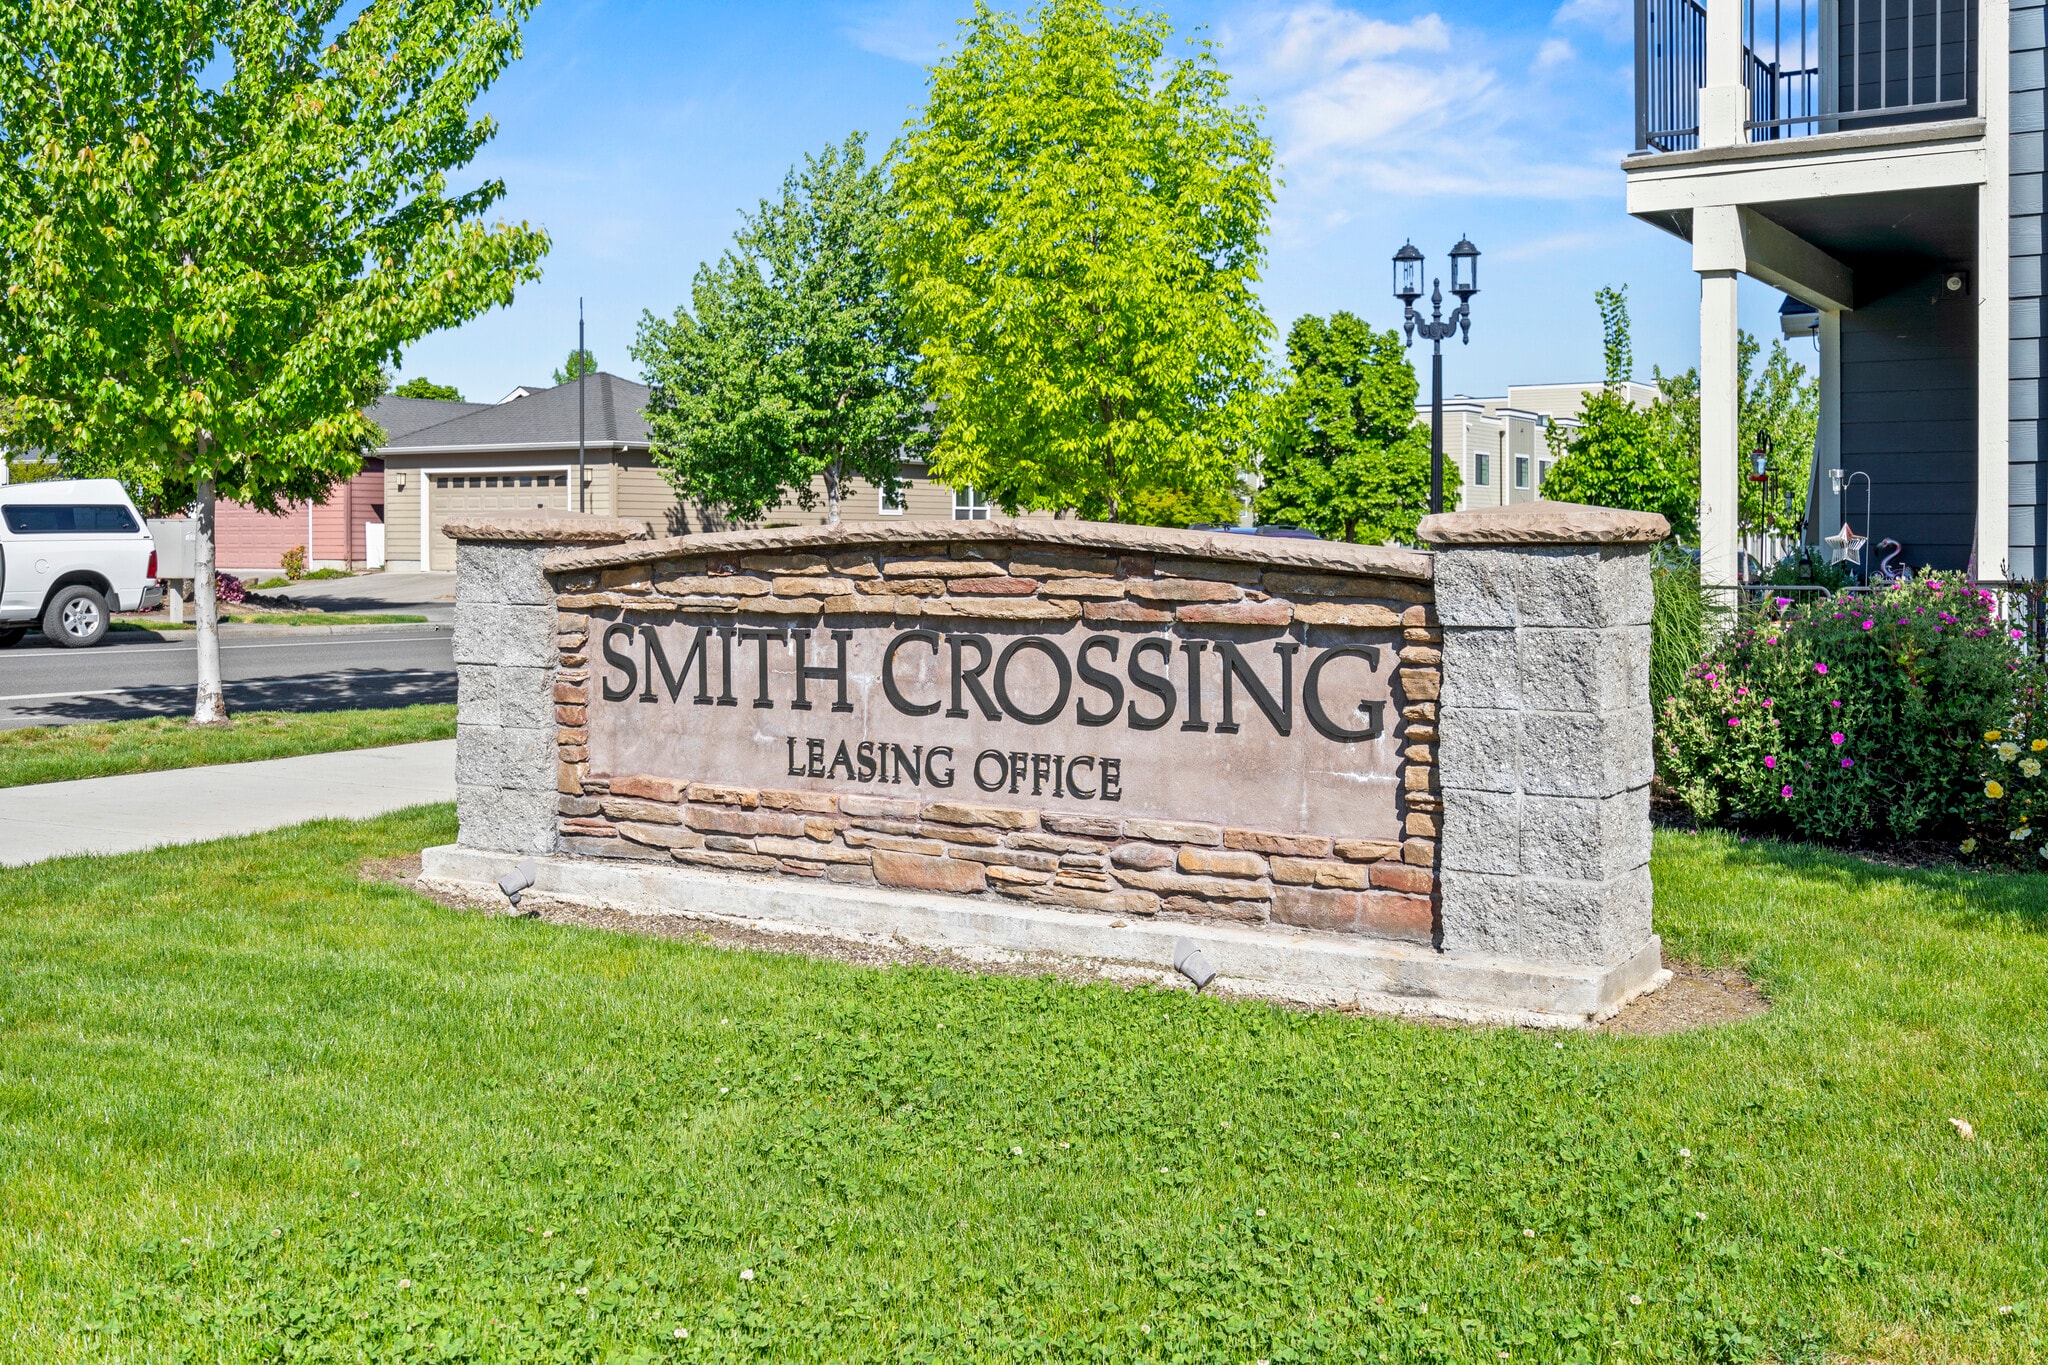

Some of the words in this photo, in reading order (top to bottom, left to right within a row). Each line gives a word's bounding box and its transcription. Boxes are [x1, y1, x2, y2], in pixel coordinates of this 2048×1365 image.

[603, 623, 854, 713] SMITH
[883, 630, 1386, 742] CROSSING
[787, 736, 955, 787] LEASING
[974, 749, 1122, 801] OFFICE
